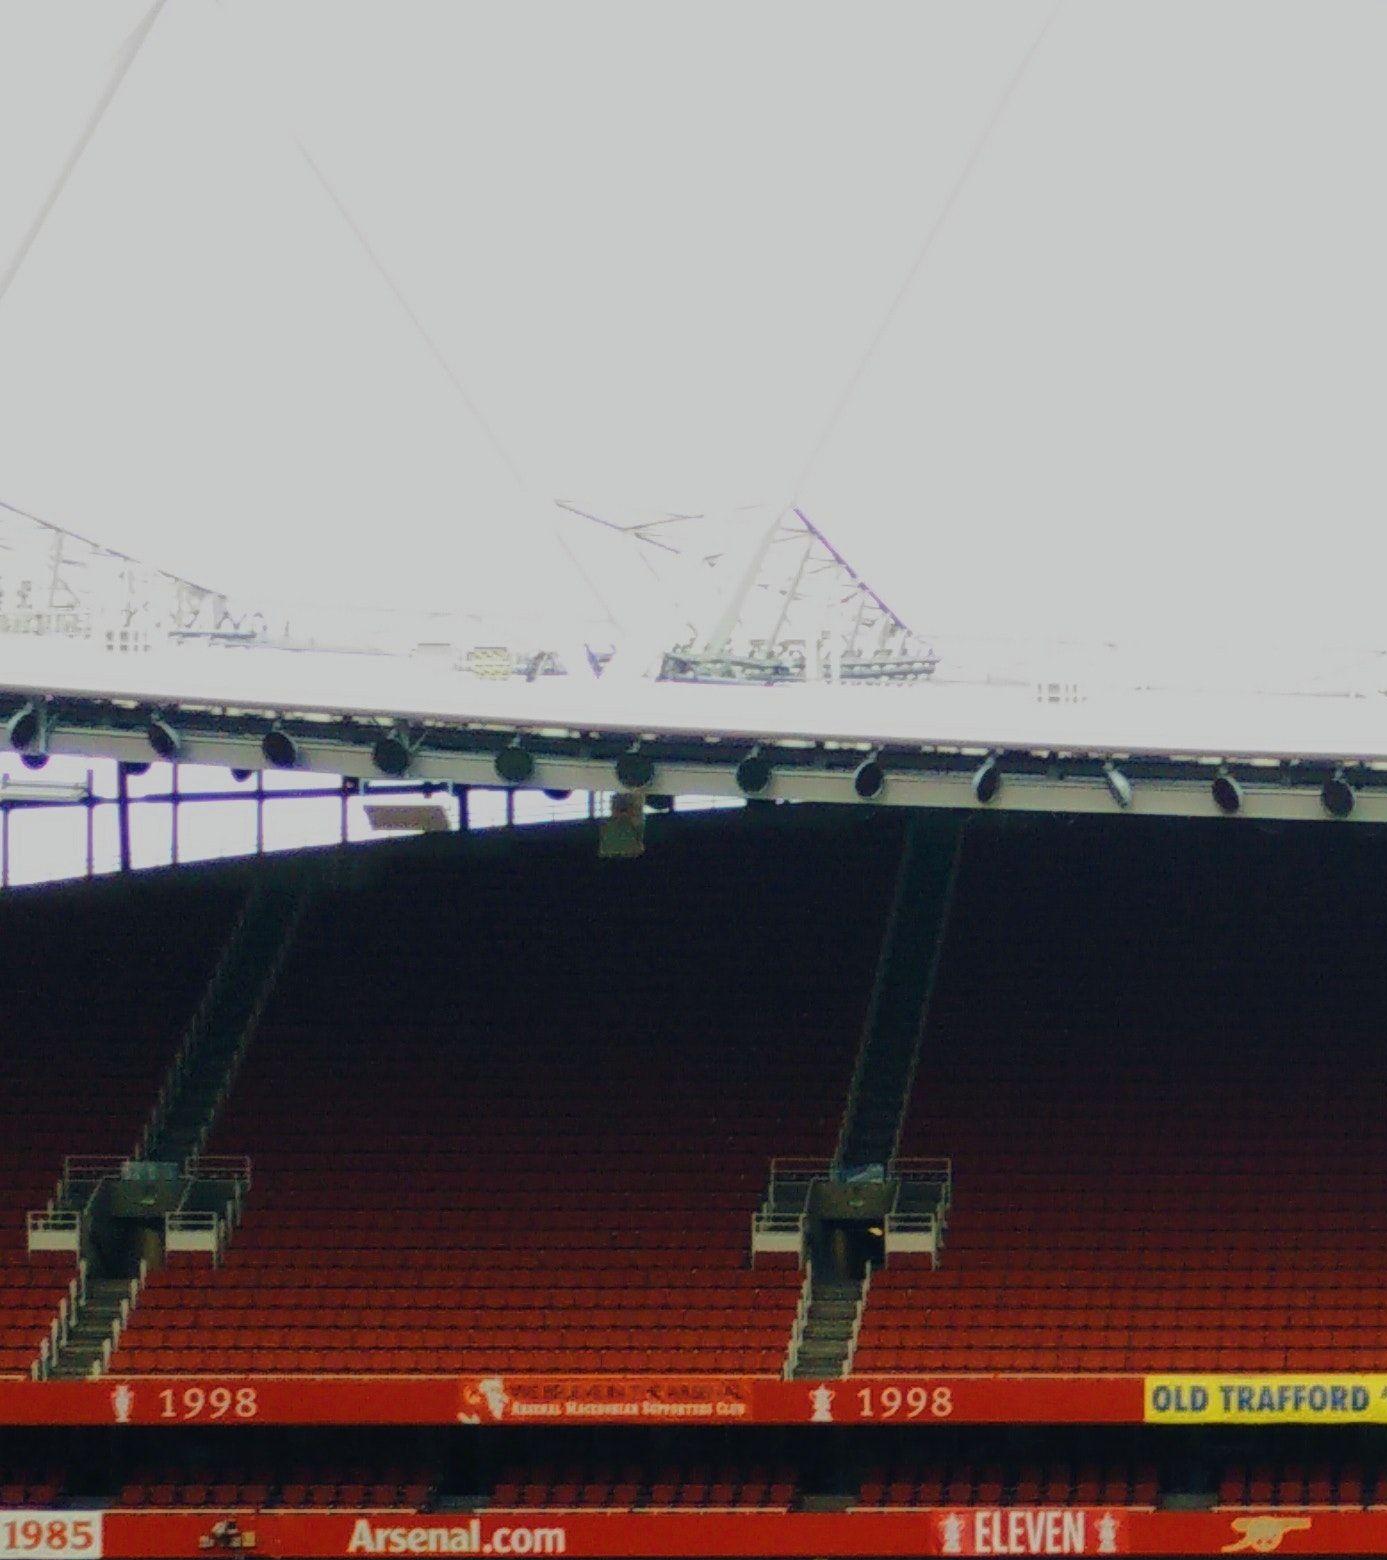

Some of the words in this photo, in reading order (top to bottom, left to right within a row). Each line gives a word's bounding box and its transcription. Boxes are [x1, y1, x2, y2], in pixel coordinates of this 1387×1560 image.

[159, 1387, 258, 1418] 1998
[856, 1386, 953, 1417] 1998
[1152, 1385, 1208, 1412] OLD
[1219, 1384, 1369, 1412] TRAFFORD
[4, 1520, 94, 1551] 1985
[347, 1518, 566, 1554] Arsenal.com
[974, 1511, 1086, 1554] ELEVEN
